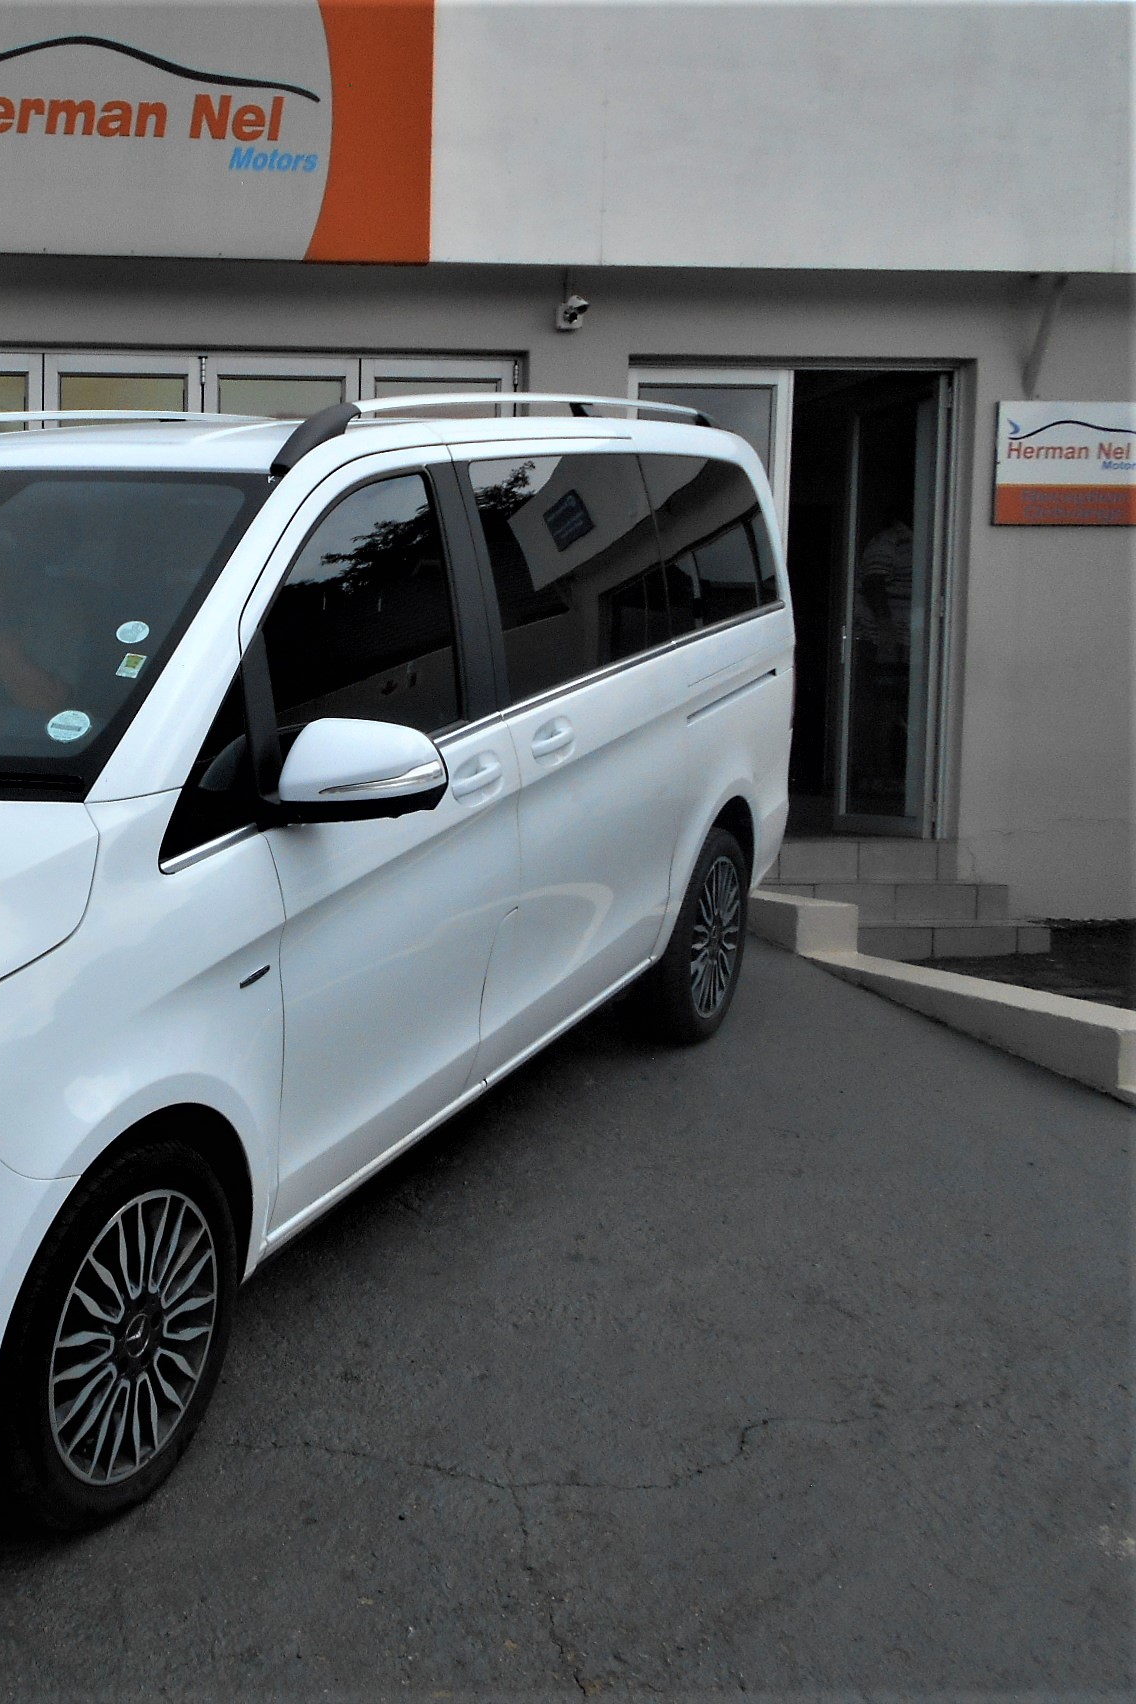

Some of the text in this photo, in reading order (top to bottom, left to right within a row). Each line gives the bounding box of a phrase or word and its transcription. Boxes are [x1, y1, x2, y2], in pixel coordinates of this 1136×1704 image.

[189, 94, 285, 141] Nel
[229, 147, 318, 172] Motors
[1007, 442, 1132, 460] Herman Nel
